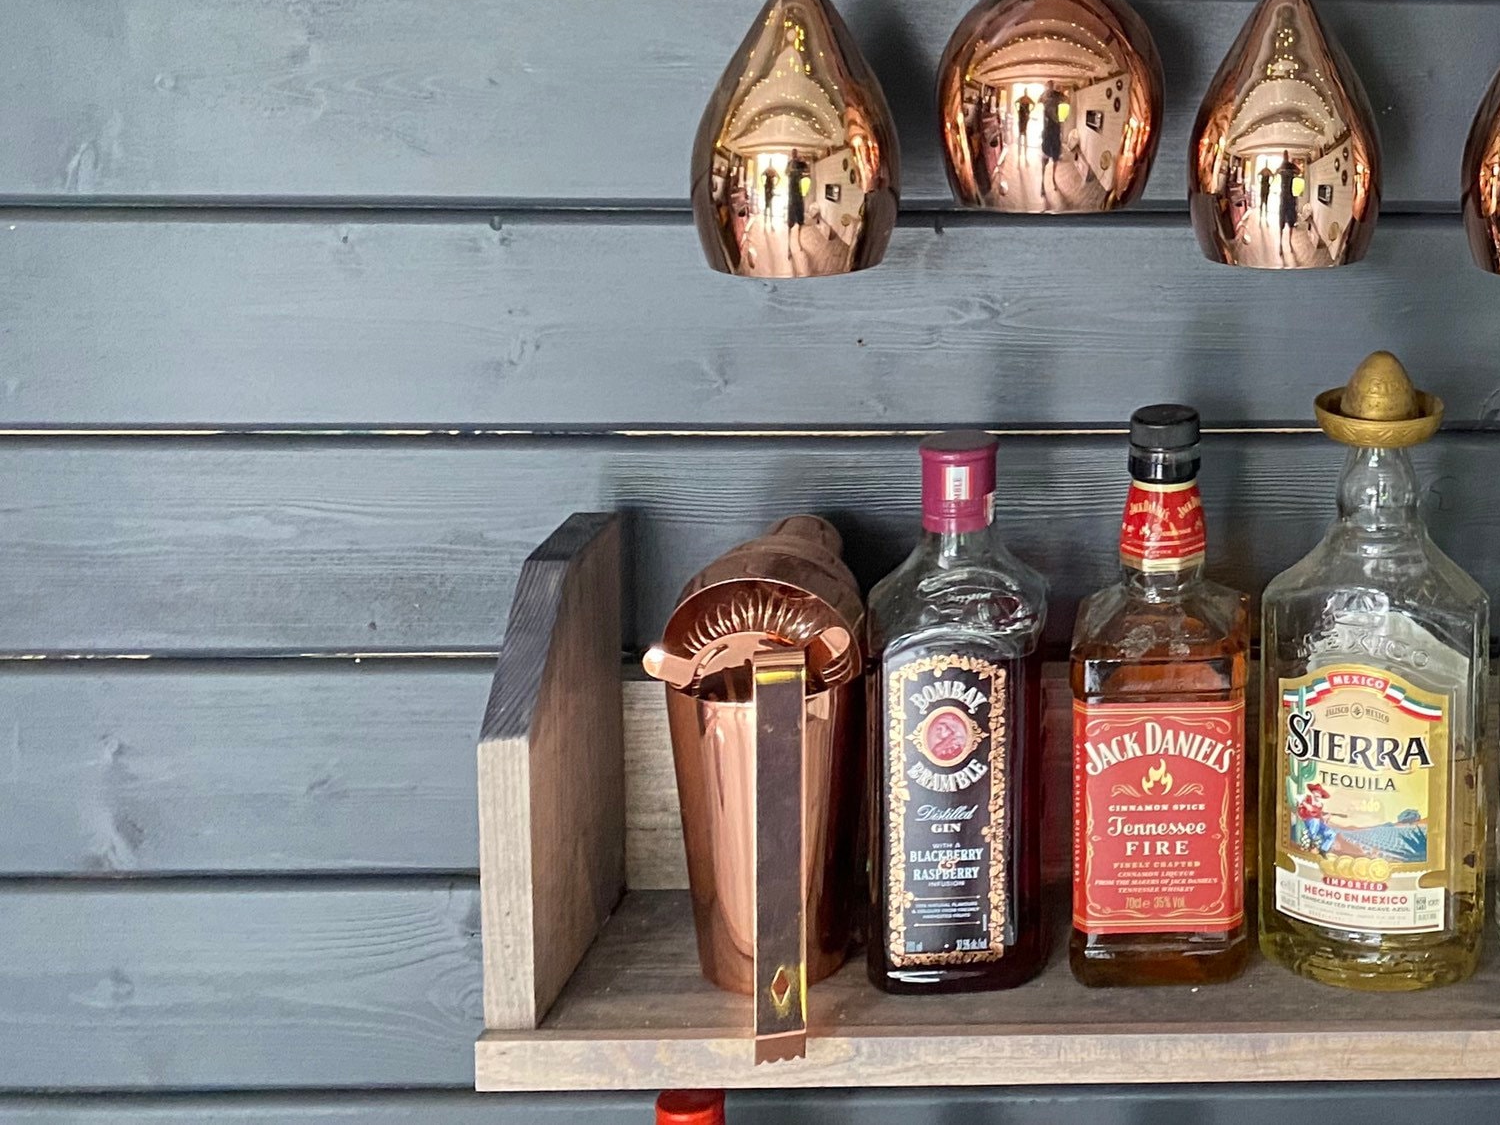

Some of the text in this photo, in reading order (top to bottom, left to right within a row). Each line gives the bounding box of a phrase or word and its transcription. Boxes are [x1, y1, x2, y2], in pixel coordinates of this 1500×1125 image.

[1333, 676, 1385, 690] MEXICO
[908, 680, 988, 715] BOMBAY
[1084, 722, 1235, 776] JACK DANIEL'S
[1287, 710, 1431, 771] SIERRA
[907, 758, 988, 792] BRAMBLE
[1319, 771, 1396, 791] TEQUILA
[915, 804, 979, 821] Distilled
[1108, 804, 1169, 812] CINNAMON
[931, 823, 962, 833] GIN
[1107, 816, 1207, 836] Tennessee
[910, 848, 984, 862] BLACKBERRY
[1125, 840, 1190, 856] FIRE
[913, 866, 980, 881] RASPBERRY
[1326, 877, 1383, 891] IMPORTED
[1304, 884, 1342, 899] HECHO
[1344, 893, 1360, 901] EN
[1361, 895, 1408, 905] MEXICO
